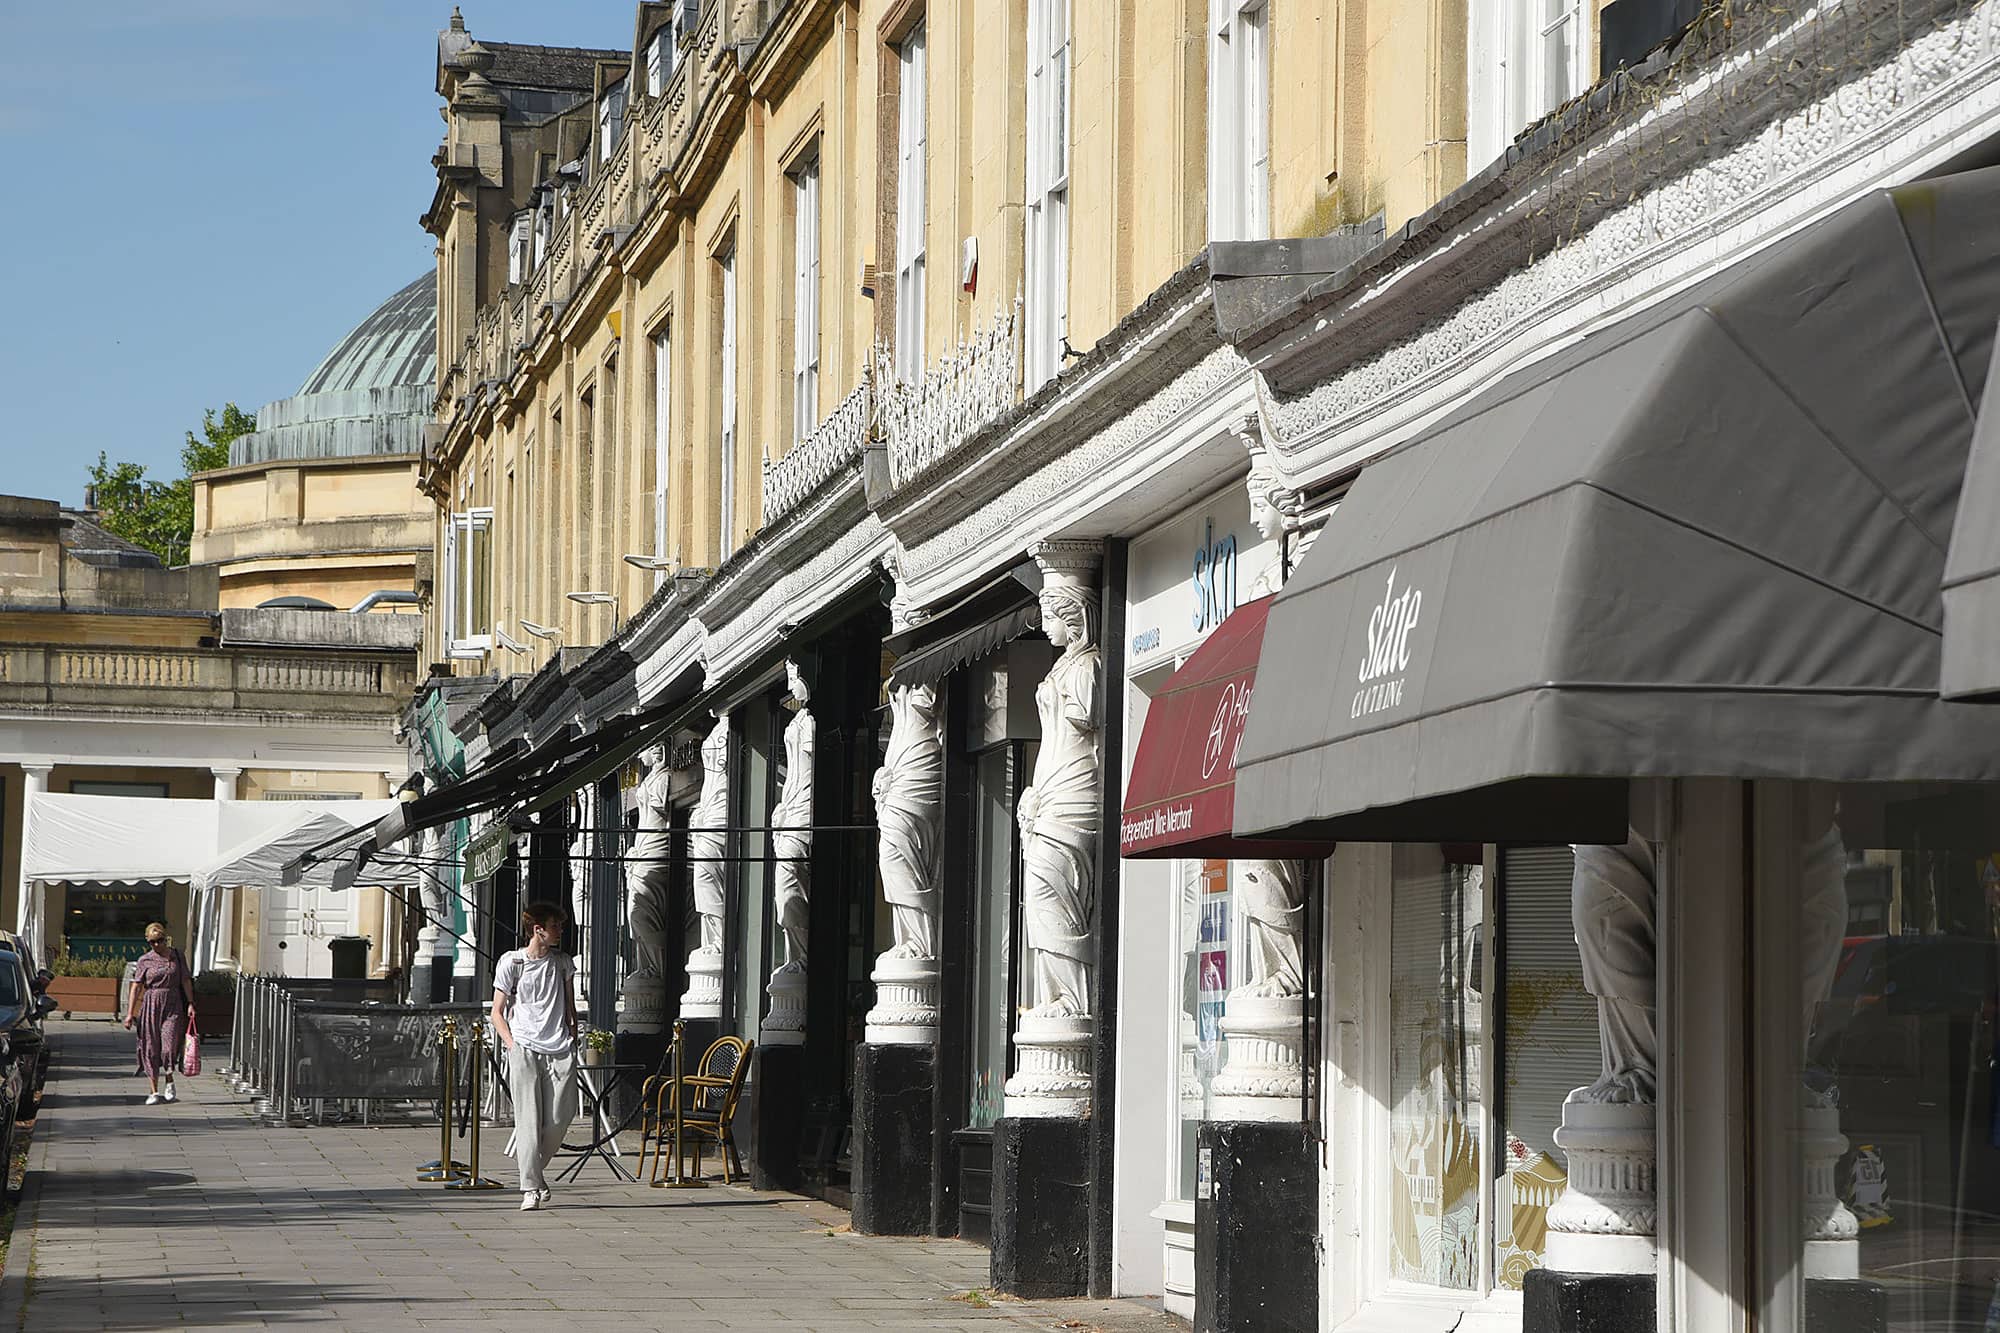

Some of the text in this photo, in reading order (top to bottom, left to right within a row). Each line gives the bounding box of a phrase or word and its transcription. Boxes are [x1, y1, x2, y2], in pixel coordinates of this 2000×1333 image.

[1359, 564, 1422, 683] slate
[1351, 678, 1405, 719] CLOTHING
[1153, 808, 1167, 836] Wine
[1166, 802, 1193, 832] Merchant
